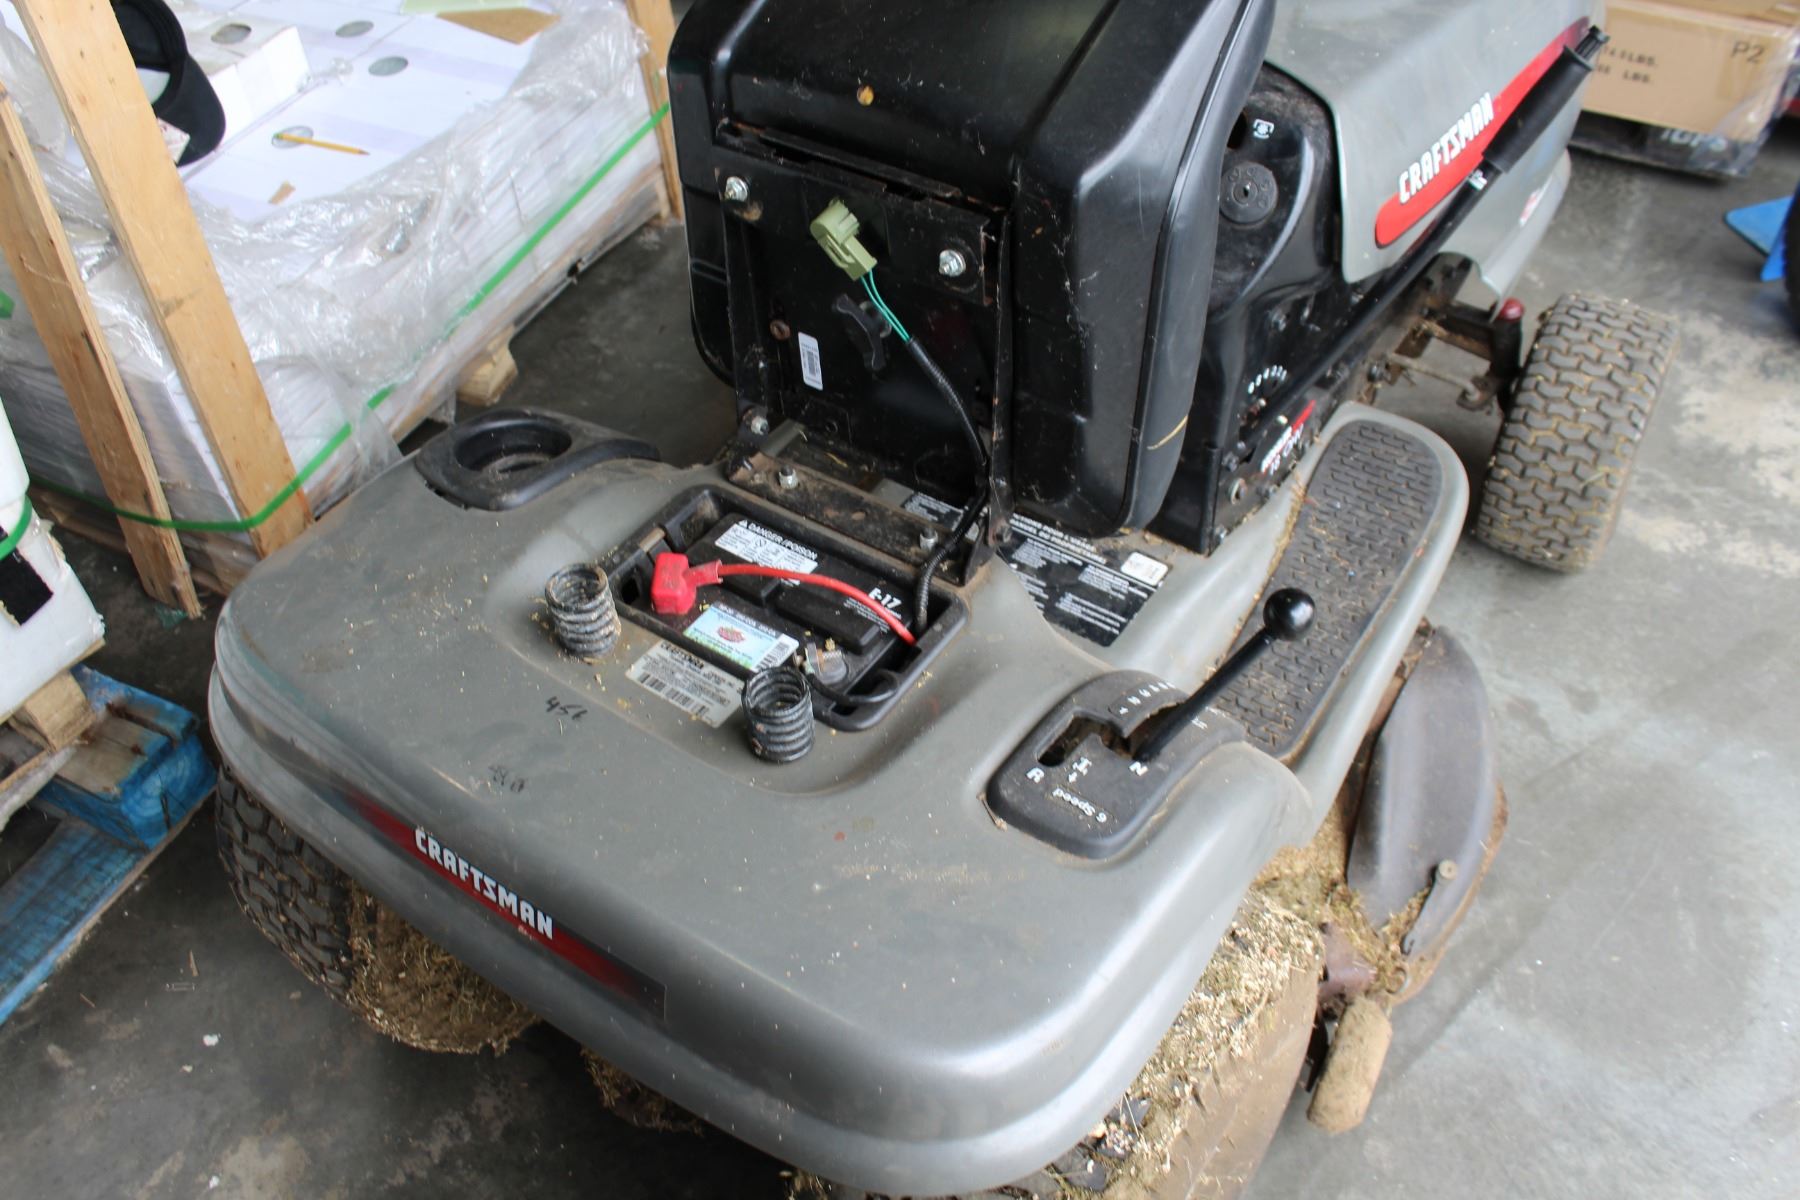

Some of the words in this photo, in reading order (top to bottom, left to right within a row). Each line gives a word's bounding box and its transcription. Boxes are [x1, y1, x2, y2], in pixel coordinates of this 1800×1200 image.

[1730, 40, 1765, 64] P2
[1398, 91, 1495, 204] CRAFTSMAN
[1026, 767, 1045, 784] R
[1052, 787, 1096, 817] Speed
[413, 827, 554, 941] CRAFTSMAN
